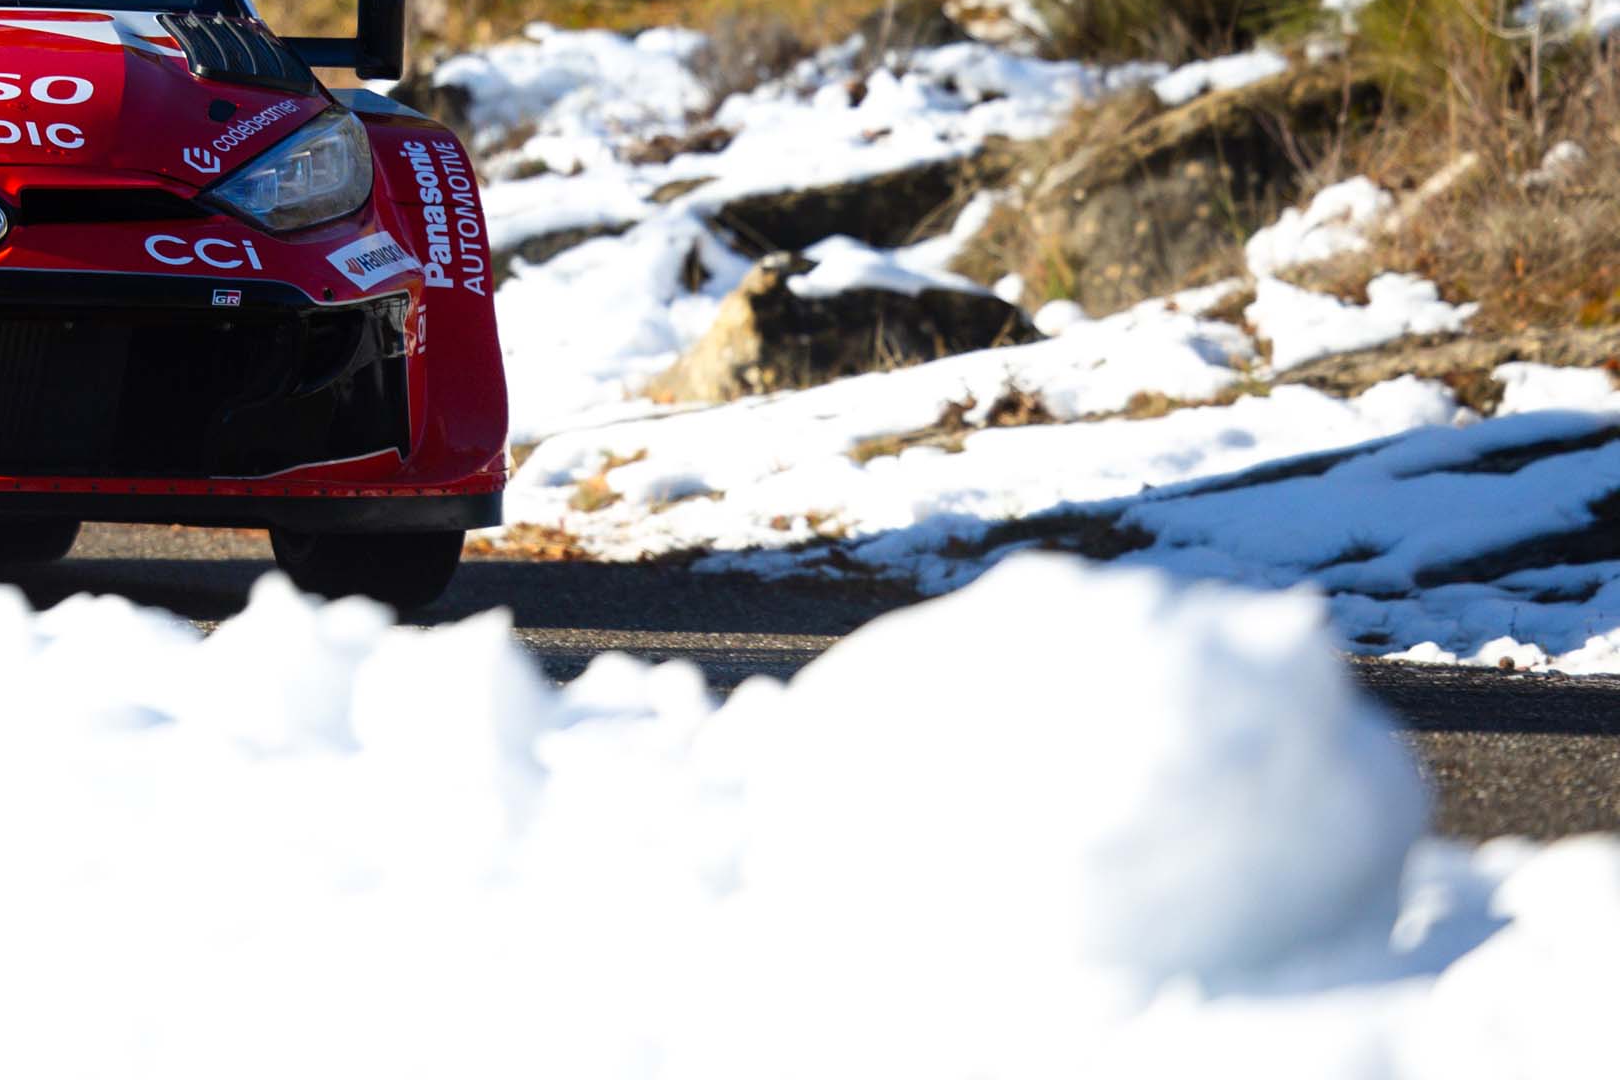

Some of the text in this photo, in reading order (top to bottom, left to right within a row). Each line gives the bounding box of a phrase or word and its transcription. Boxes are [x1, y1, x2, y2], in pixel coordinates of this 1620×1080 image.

[212, 99, 301, 152] codebeamer
[399, 140, 455, 289] Panasonic
[431, 140, 486, 296] AUTOMOTIVE
[214, 293, 240, 305] GR
